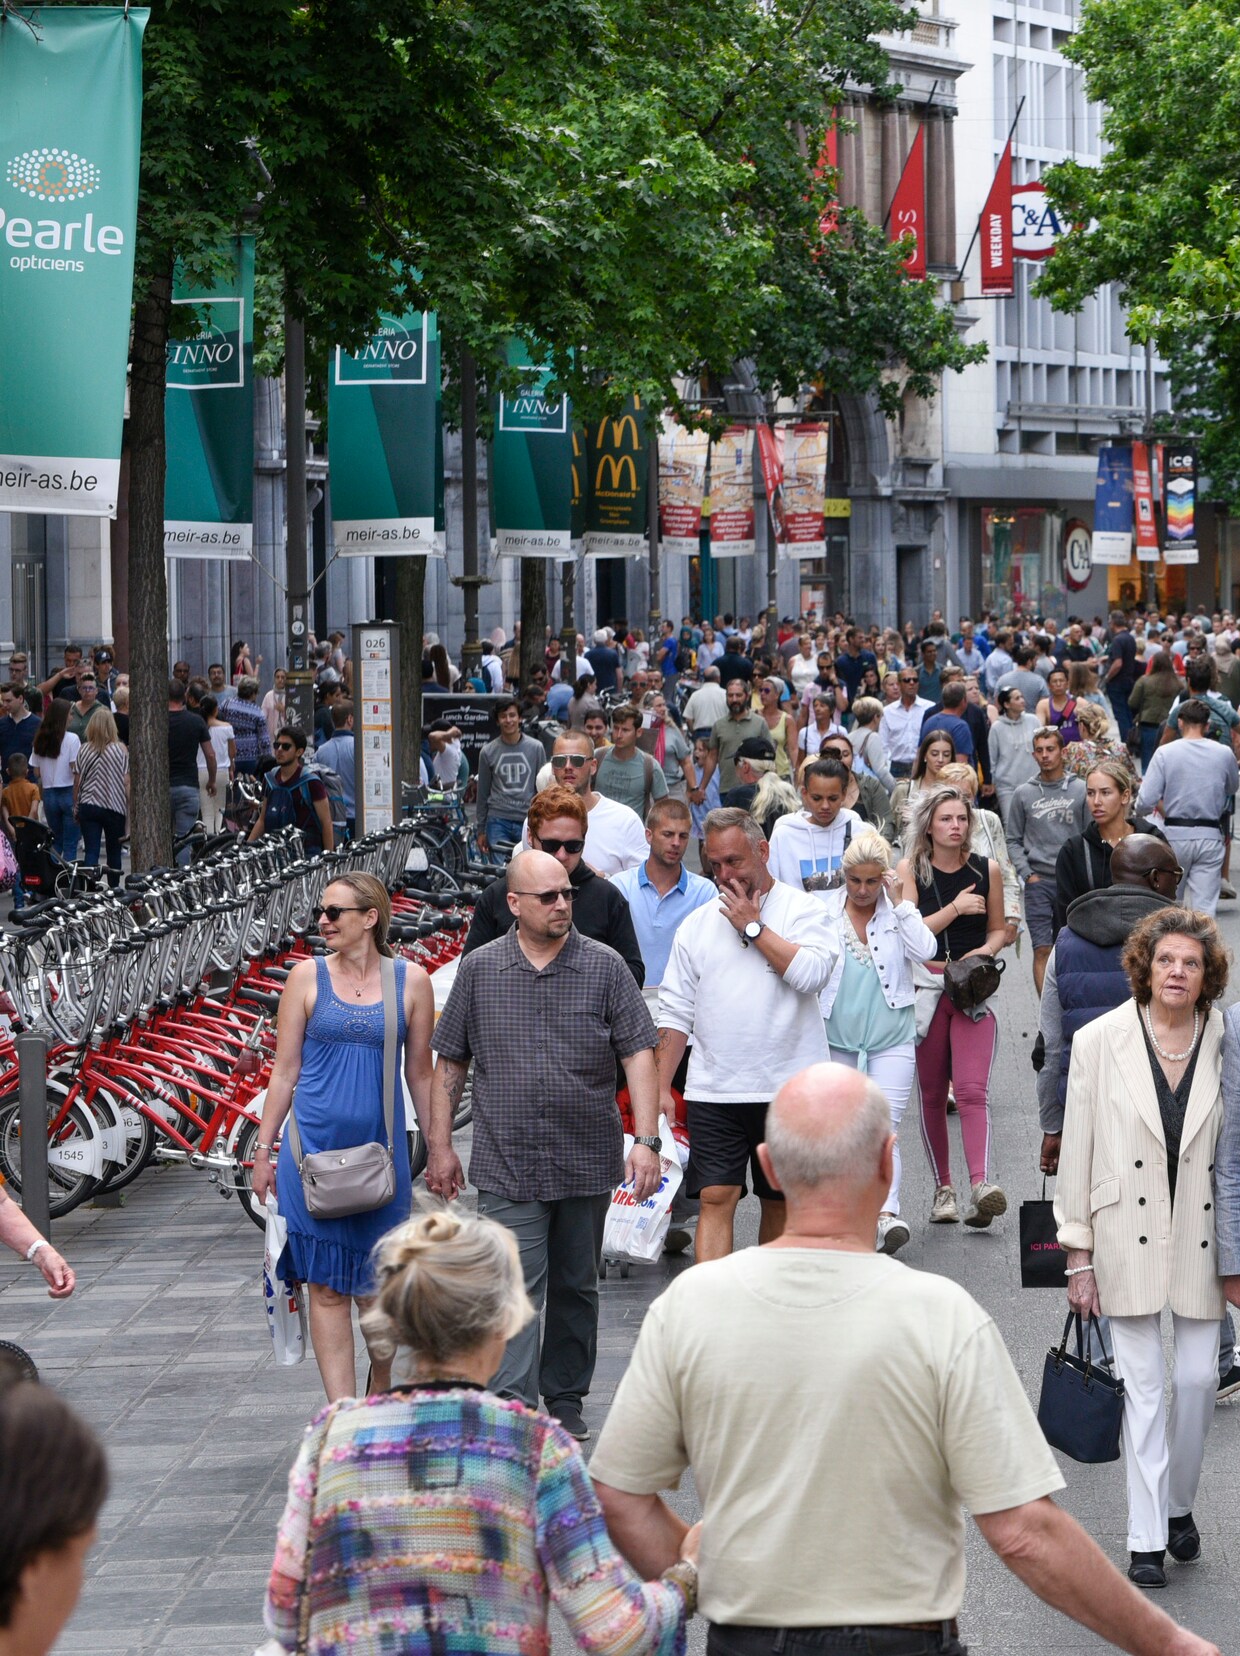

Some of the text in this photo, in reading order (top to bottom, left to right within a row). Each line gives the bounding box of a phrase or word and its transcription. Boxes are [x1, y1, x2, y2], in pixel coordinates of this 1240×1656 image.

[0, 207, 124, 255] earle
[990, 213, 1003, 269] WEEKDAY
[10, 254, 84, 272] opticiens
[172, 343, 234, 365] INNO
[512, 398, 559, 415] INNO
[164, 529, 241, 544] meir-as.be
[346, 527, 421, 542] meir-as.be
[505, 535, 561, 547] meir-as.be
[589, 535, 640, 547] meir-as.be
[365, 638, 386, 649] 026
[58, 1150, 84, 1160] 1545
[1030, 1242, 1060, 1251] ICI PAR
